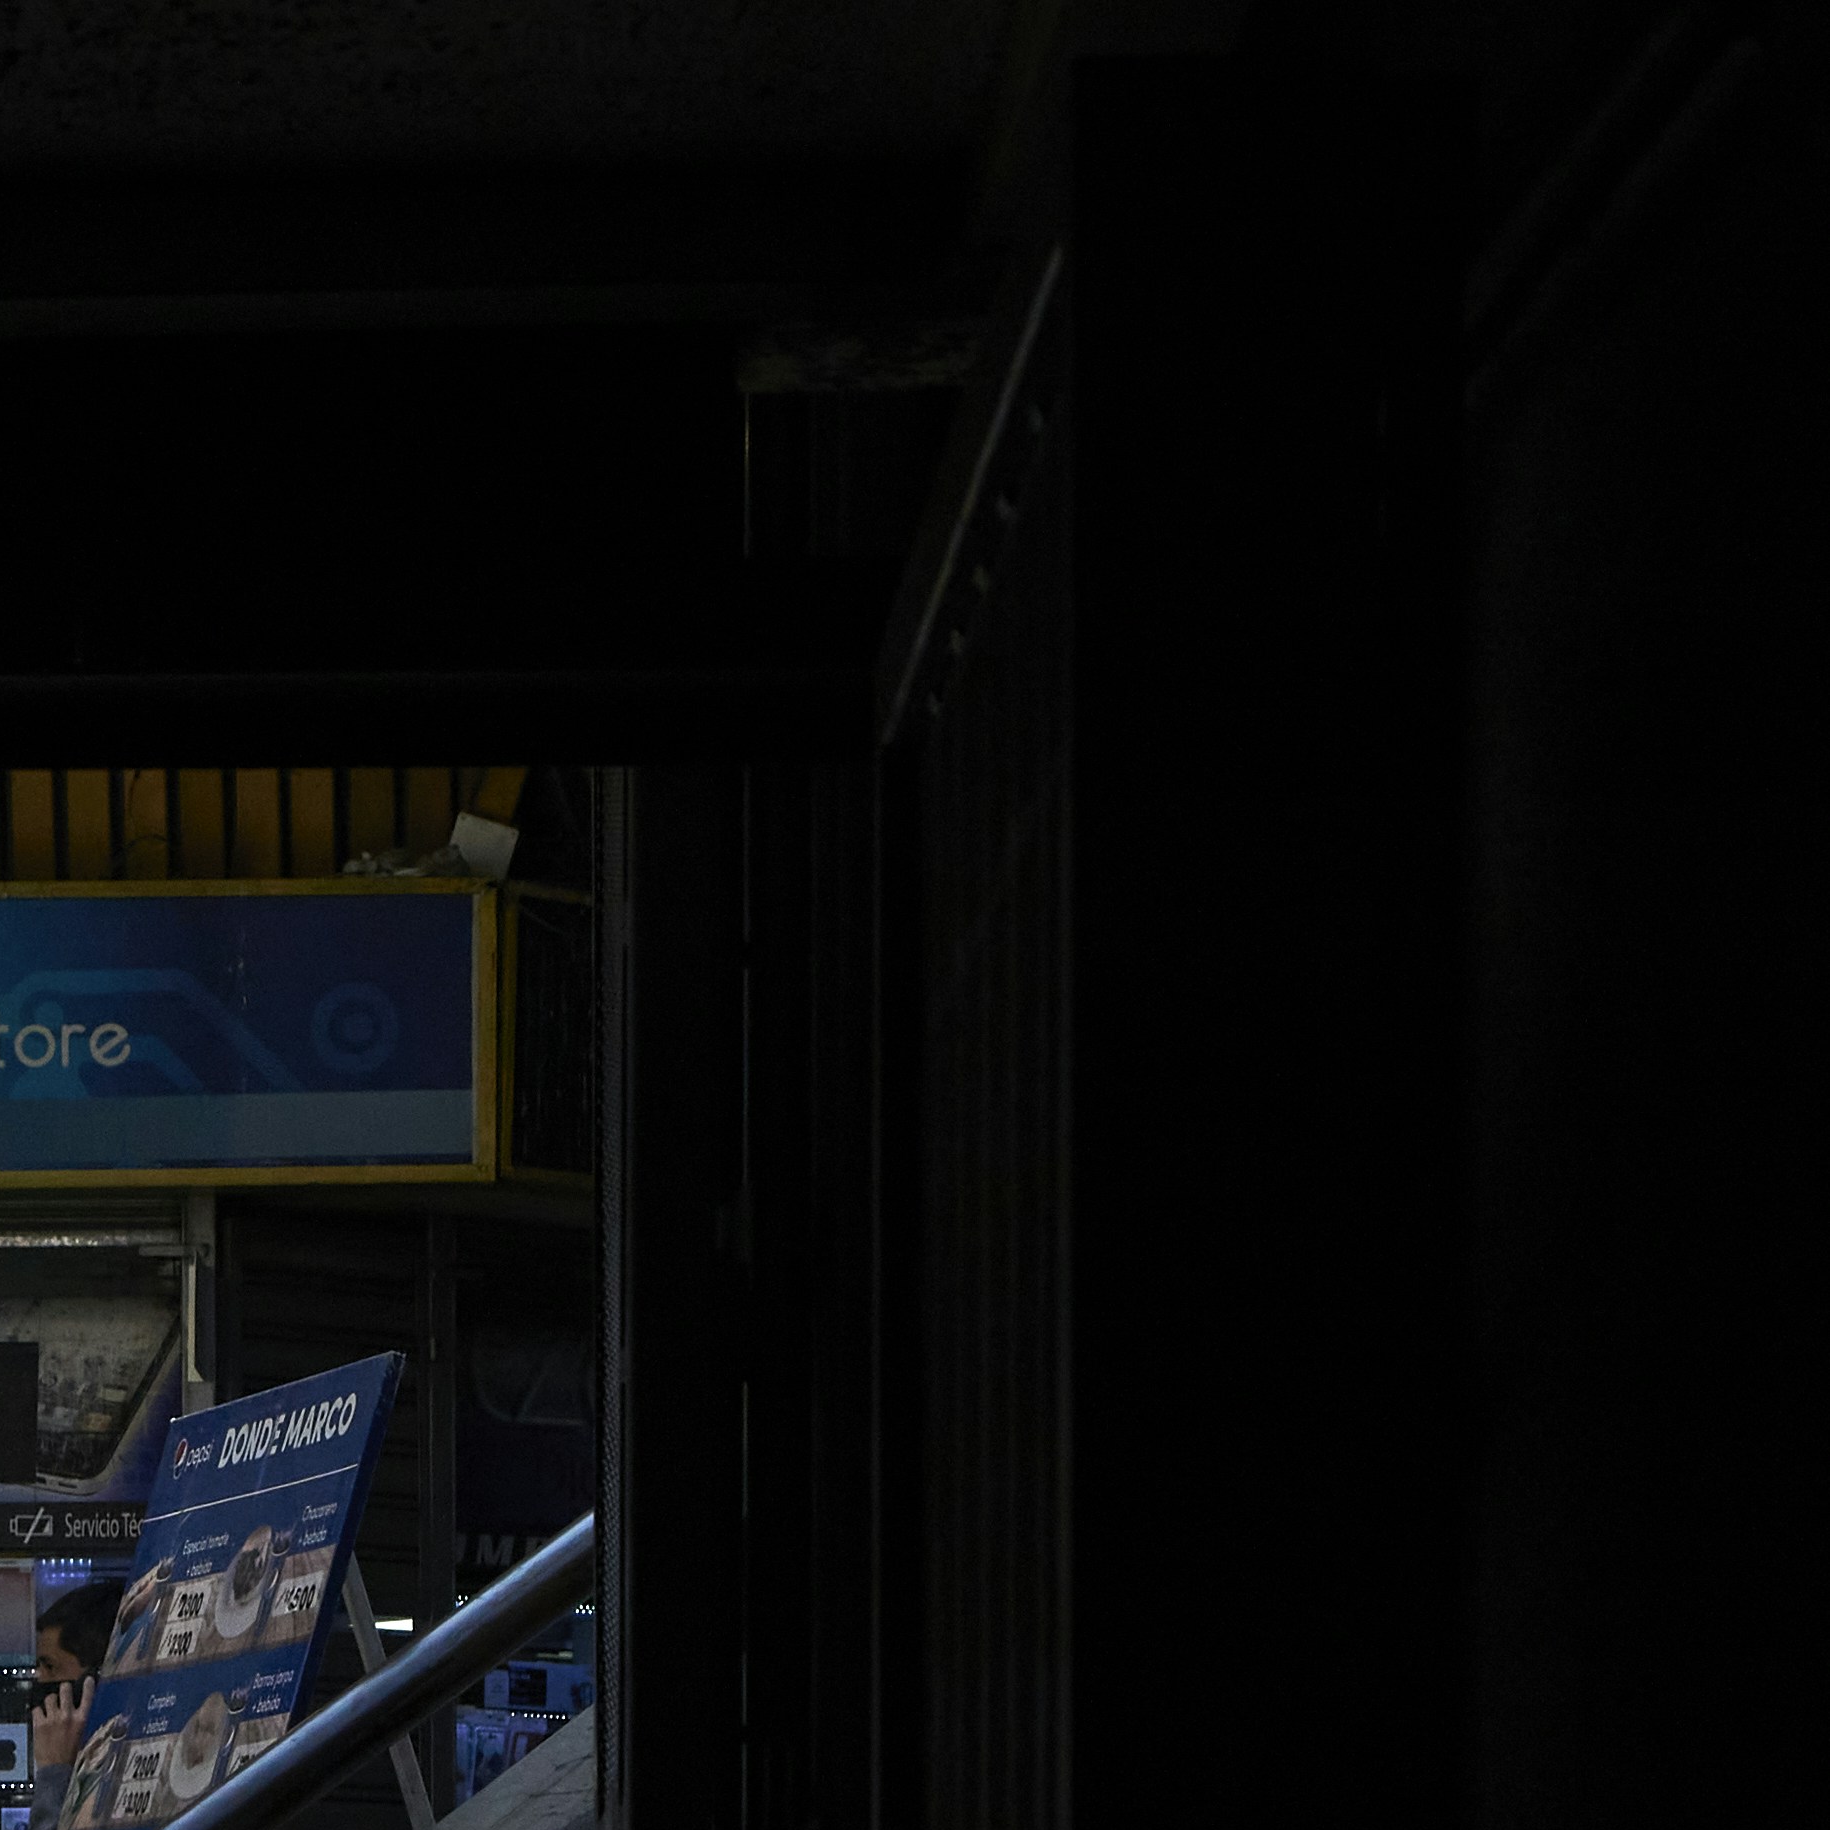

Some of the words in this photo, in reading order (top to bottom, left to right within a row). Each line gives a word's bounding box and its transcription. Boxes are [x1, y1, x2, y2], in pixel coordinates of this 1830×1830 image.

[215, 1411, 288, 1471] DONDE
[279, 1390, 361, 1453] MARCO
[182, 1437, 216, 1473] pepsi
[64, 1512, 121, 1539] Servicio
